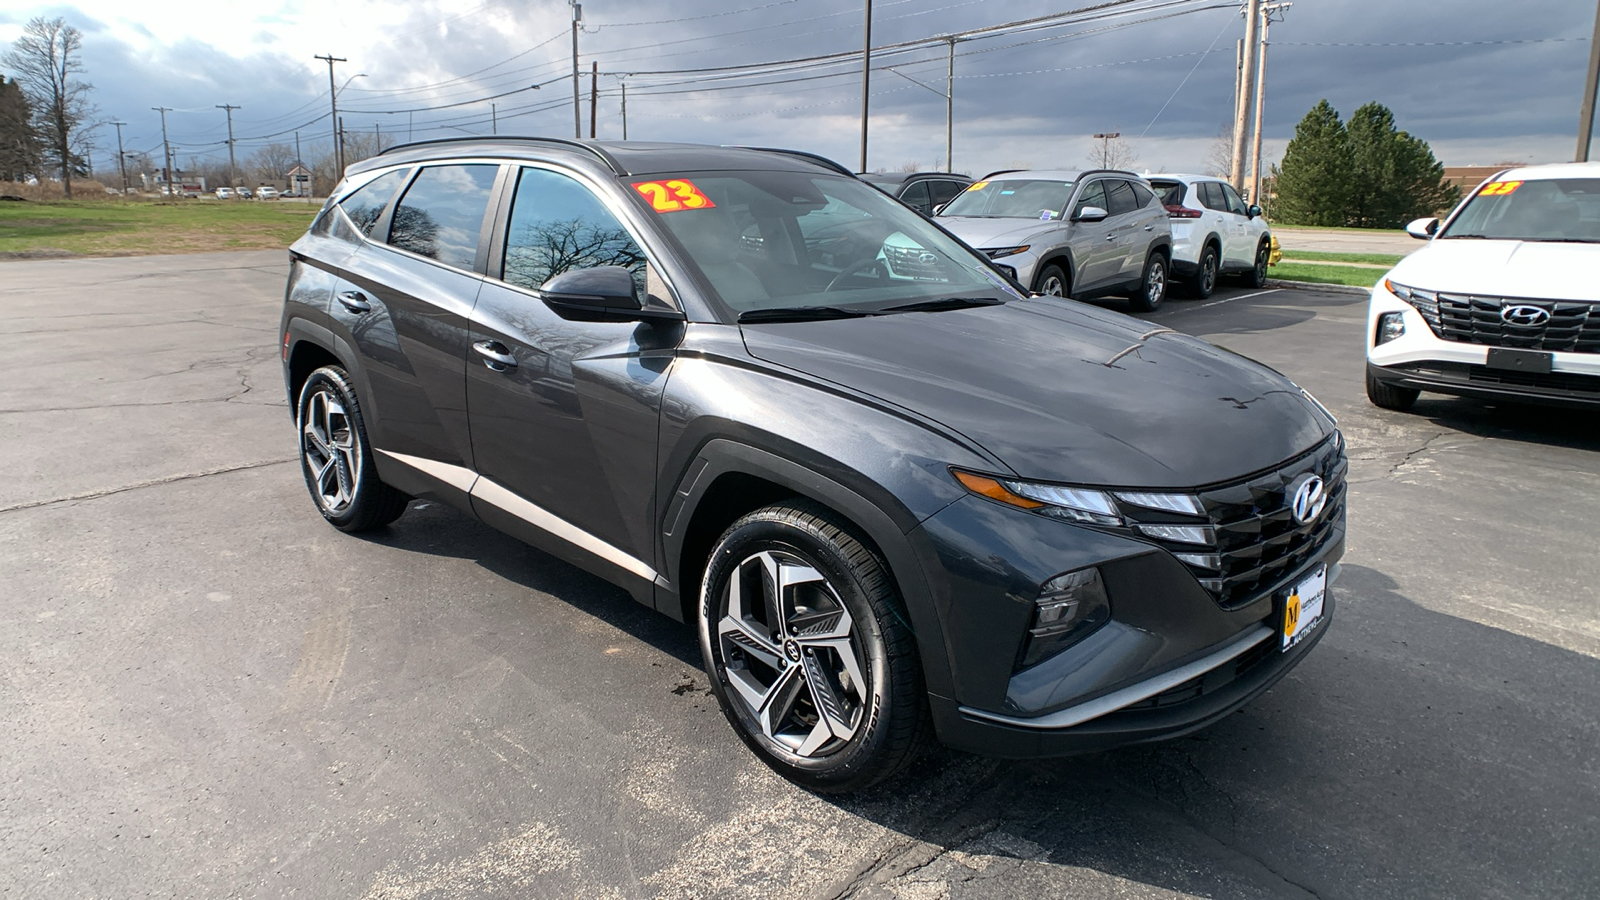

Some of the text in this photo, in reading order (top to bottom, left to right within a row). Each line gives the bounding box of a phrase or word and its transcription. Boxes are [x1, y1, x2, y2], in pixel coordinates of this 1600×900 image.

[637, 180, 708, 212] 23
[1480, 181, 1521, 195] 23
[1286, 602, 1299, 628] M
